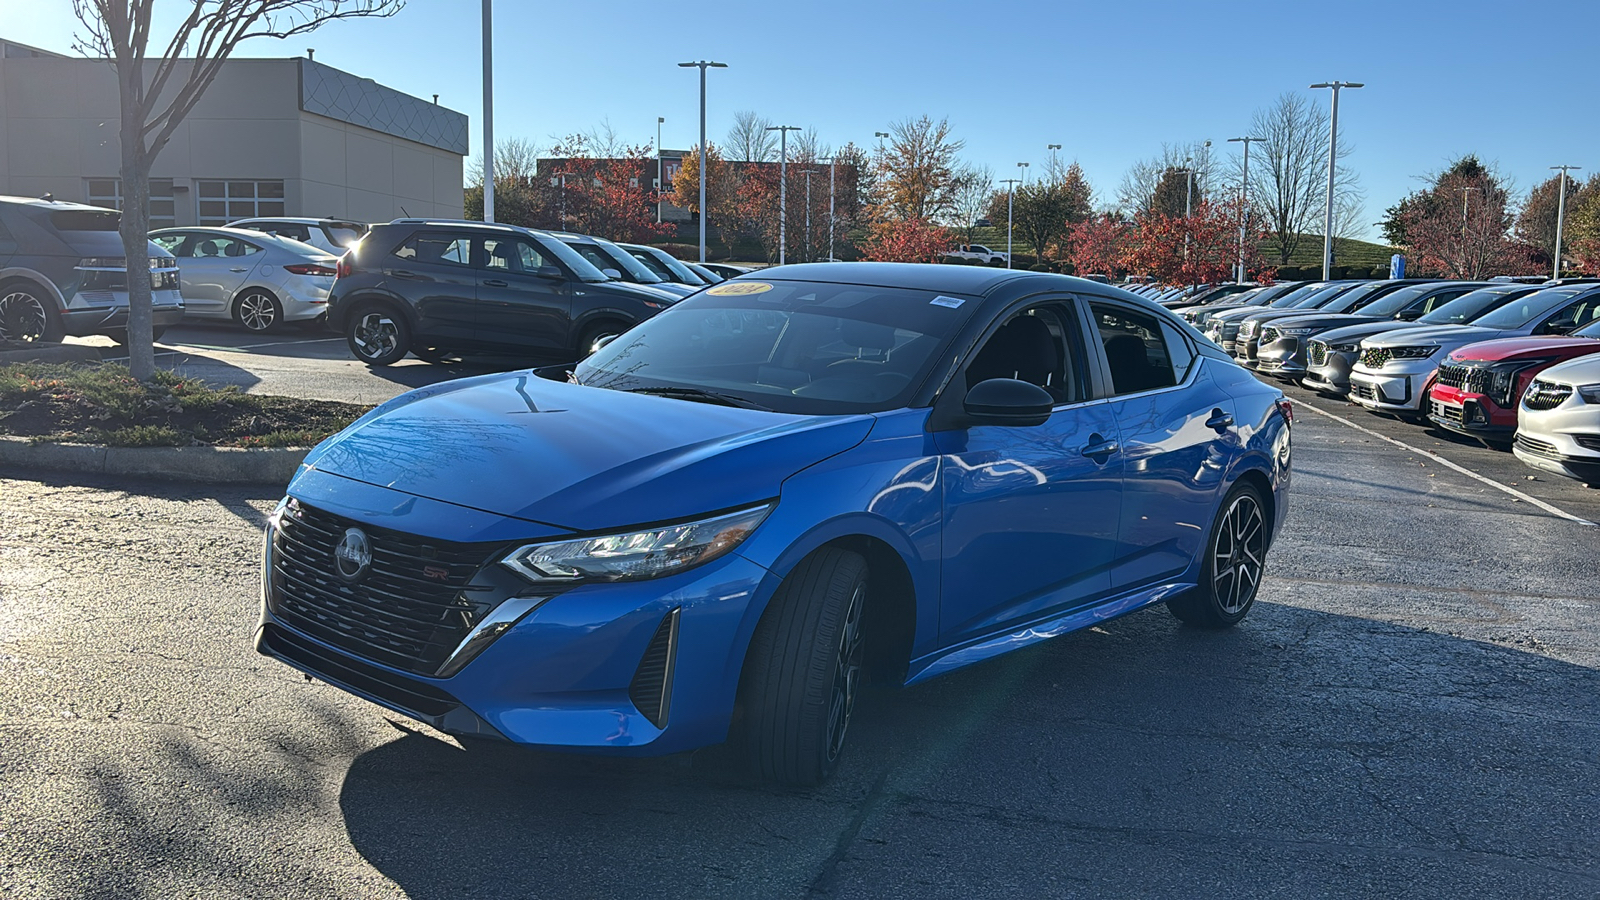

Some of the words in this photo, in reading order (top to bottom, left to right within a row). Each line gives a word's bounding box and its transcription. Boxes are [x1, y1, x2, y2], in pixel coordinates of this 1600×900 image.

[711, 284, 766, 294] 2024
[335, 545, 372, 566] NISSAN
[423, 565, 449, 581] SR
